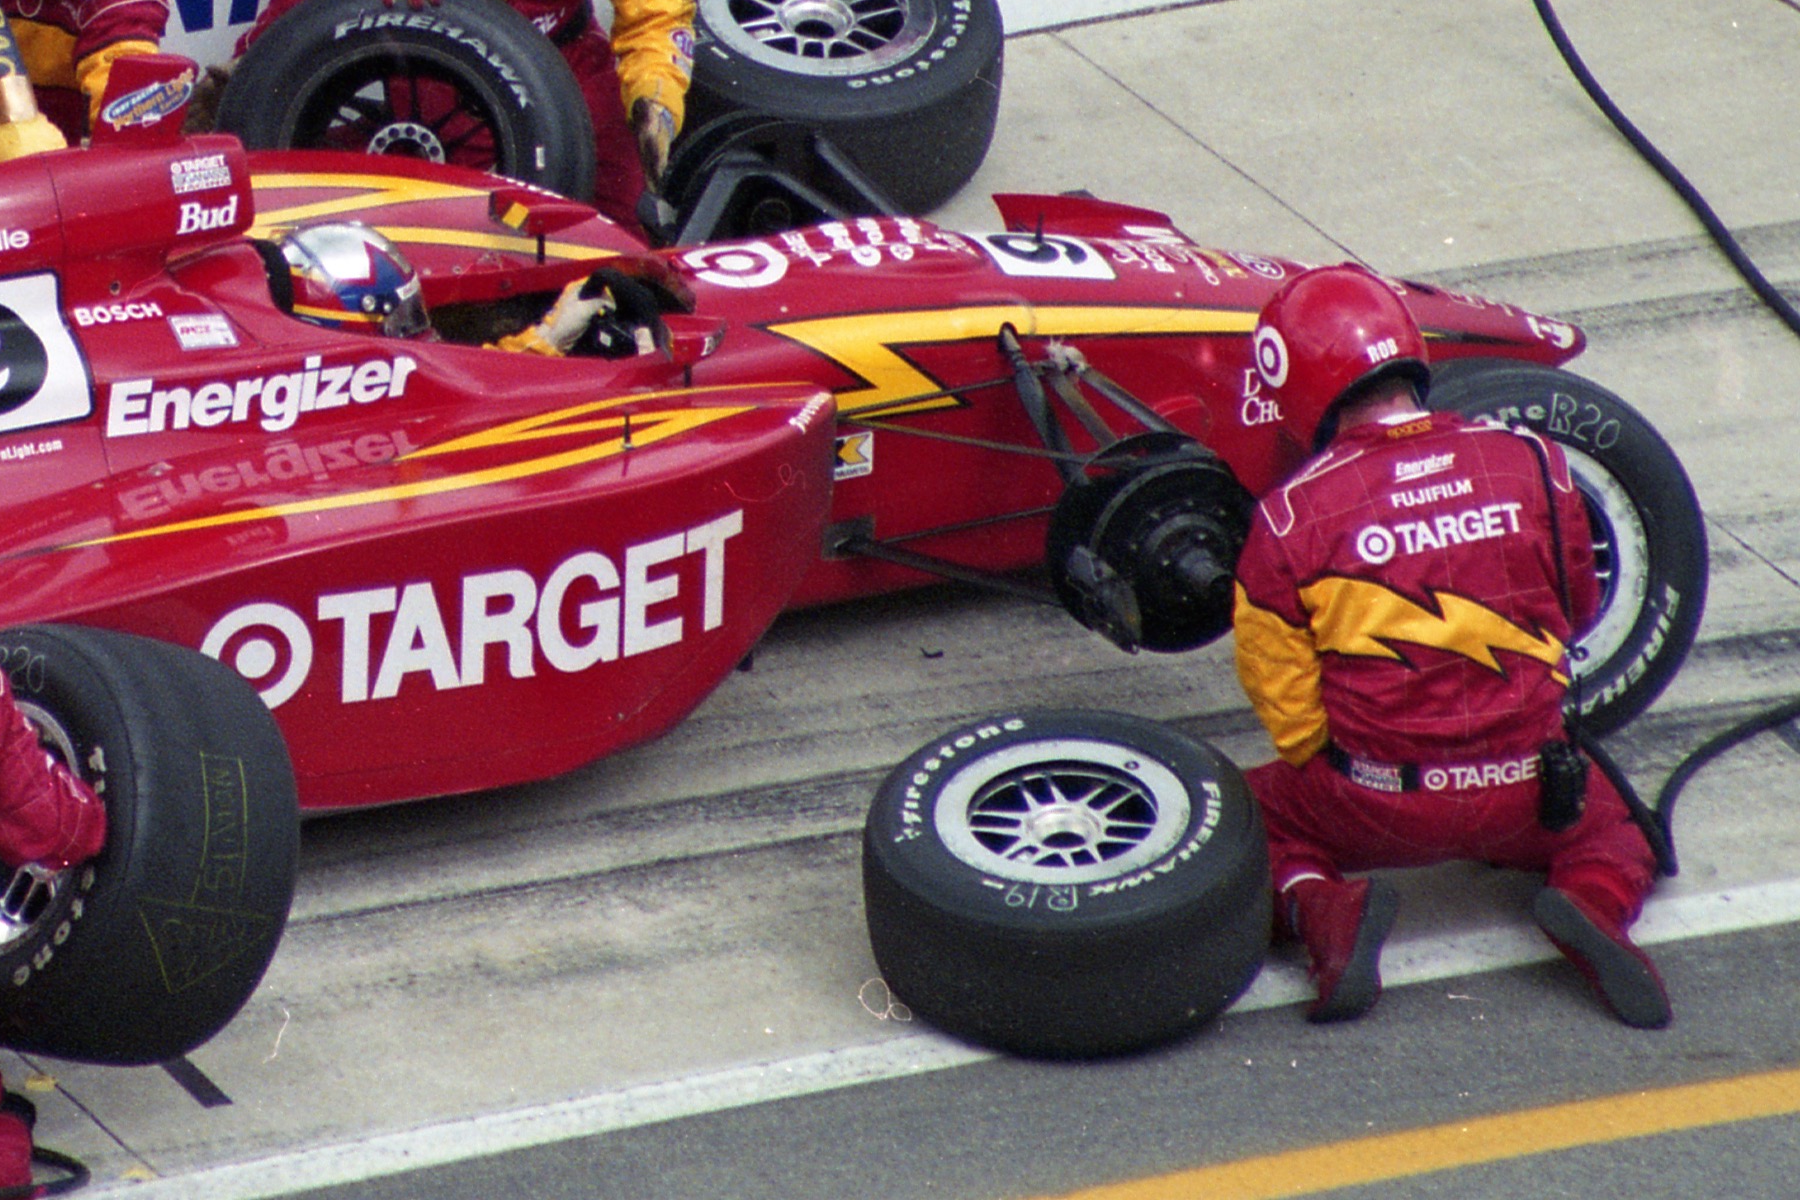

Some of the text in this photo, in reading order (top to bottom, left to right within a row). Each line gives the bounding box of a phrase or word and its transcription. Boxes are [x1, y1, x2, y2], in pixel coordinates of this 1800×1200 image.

[334, 12, 531, 108] FIREHAWK
[175, 194, 238, 235] Bud
[73, 301, 163, 327] BOSCH
[1366, 337, 1399, 363] ROB
[105, 354, 418, 437] Energizer
[1546, 391, 1623, 451] R20
[1386, 418, 1433, 439] sparco
[1394, 452, 1456, 478] Energizer
[1390, 478, 1473, 509] FUJIFILM
[1394, 502, 1523, 555] TARGET
[317, 508, 744, 704] TARGET
[903, 717, 1026, 826] Firestone
[12, 745, 107, 988] Fistone
[1088, 779, 1223, 898] FIREHAWK
